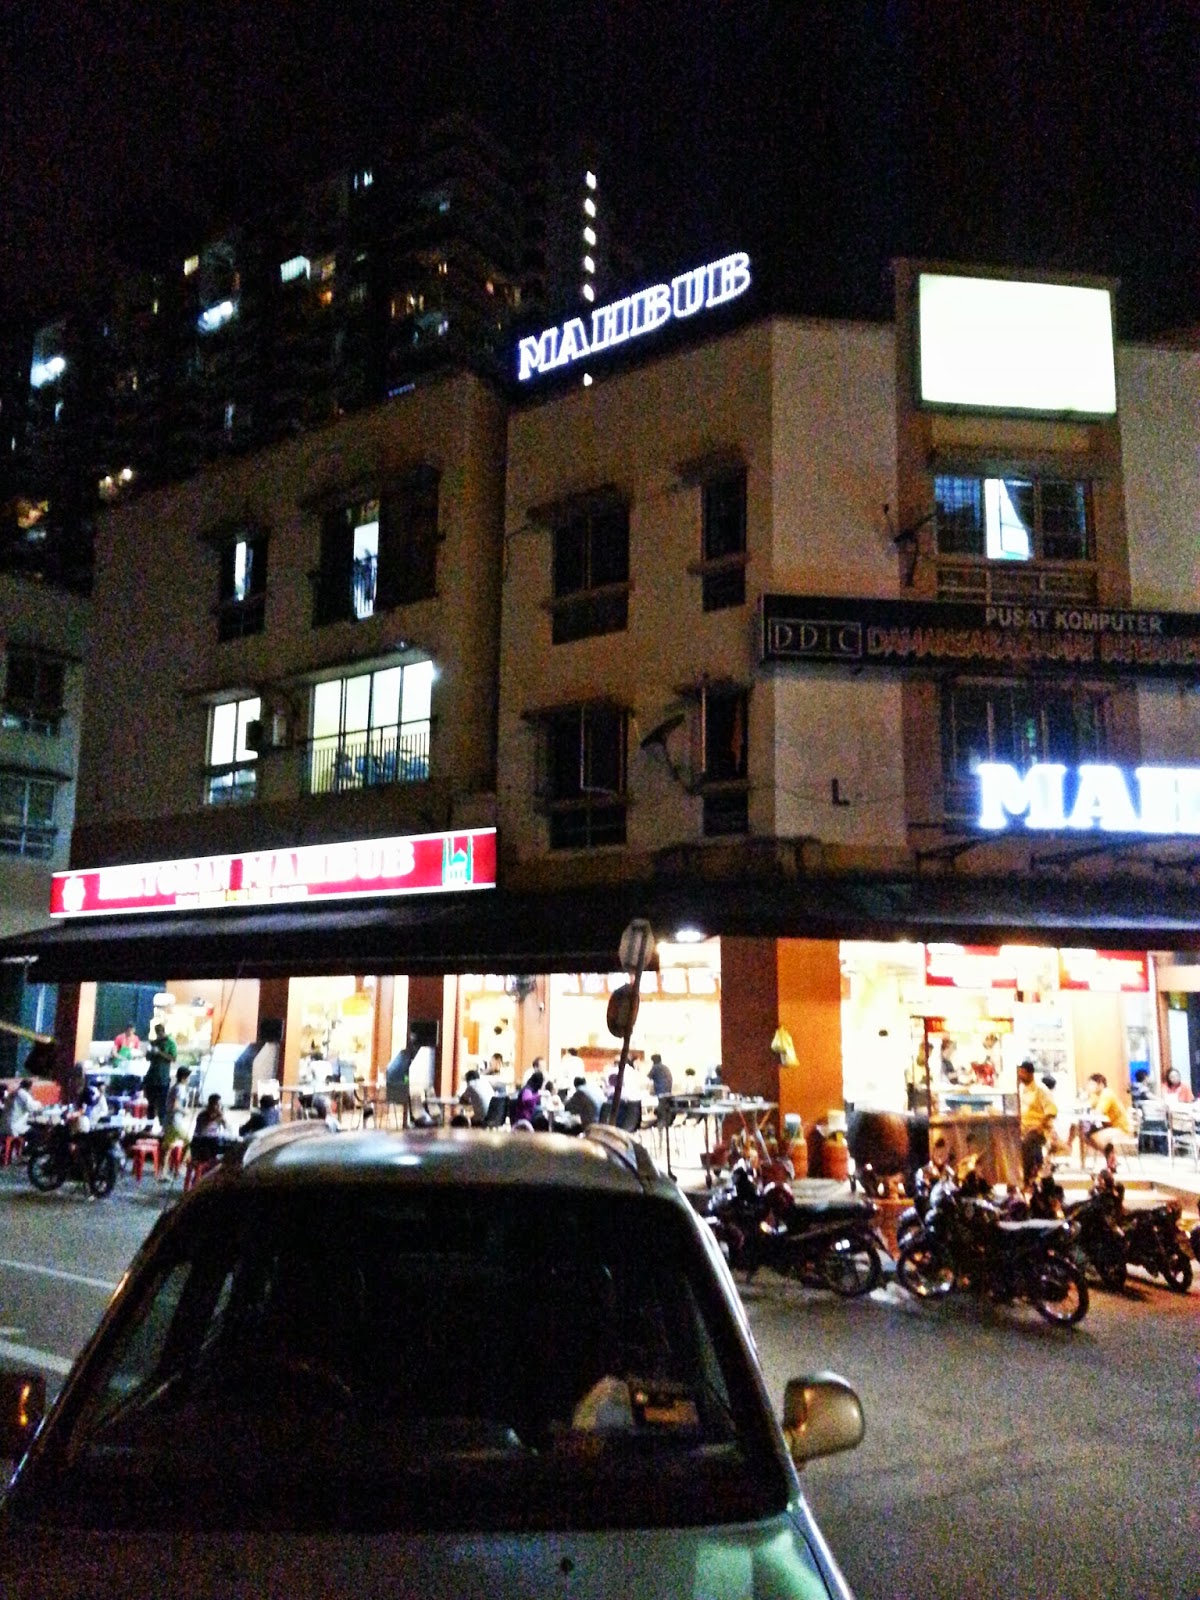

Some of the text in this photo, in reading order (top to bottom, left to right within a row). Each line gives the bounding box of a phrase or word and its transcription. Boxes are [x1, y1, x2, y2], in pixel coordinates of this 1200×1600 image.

[517, 251, 752, 381] MAHBUB
[985, 606, 1164, 633] PUSAT KOMPUTER
